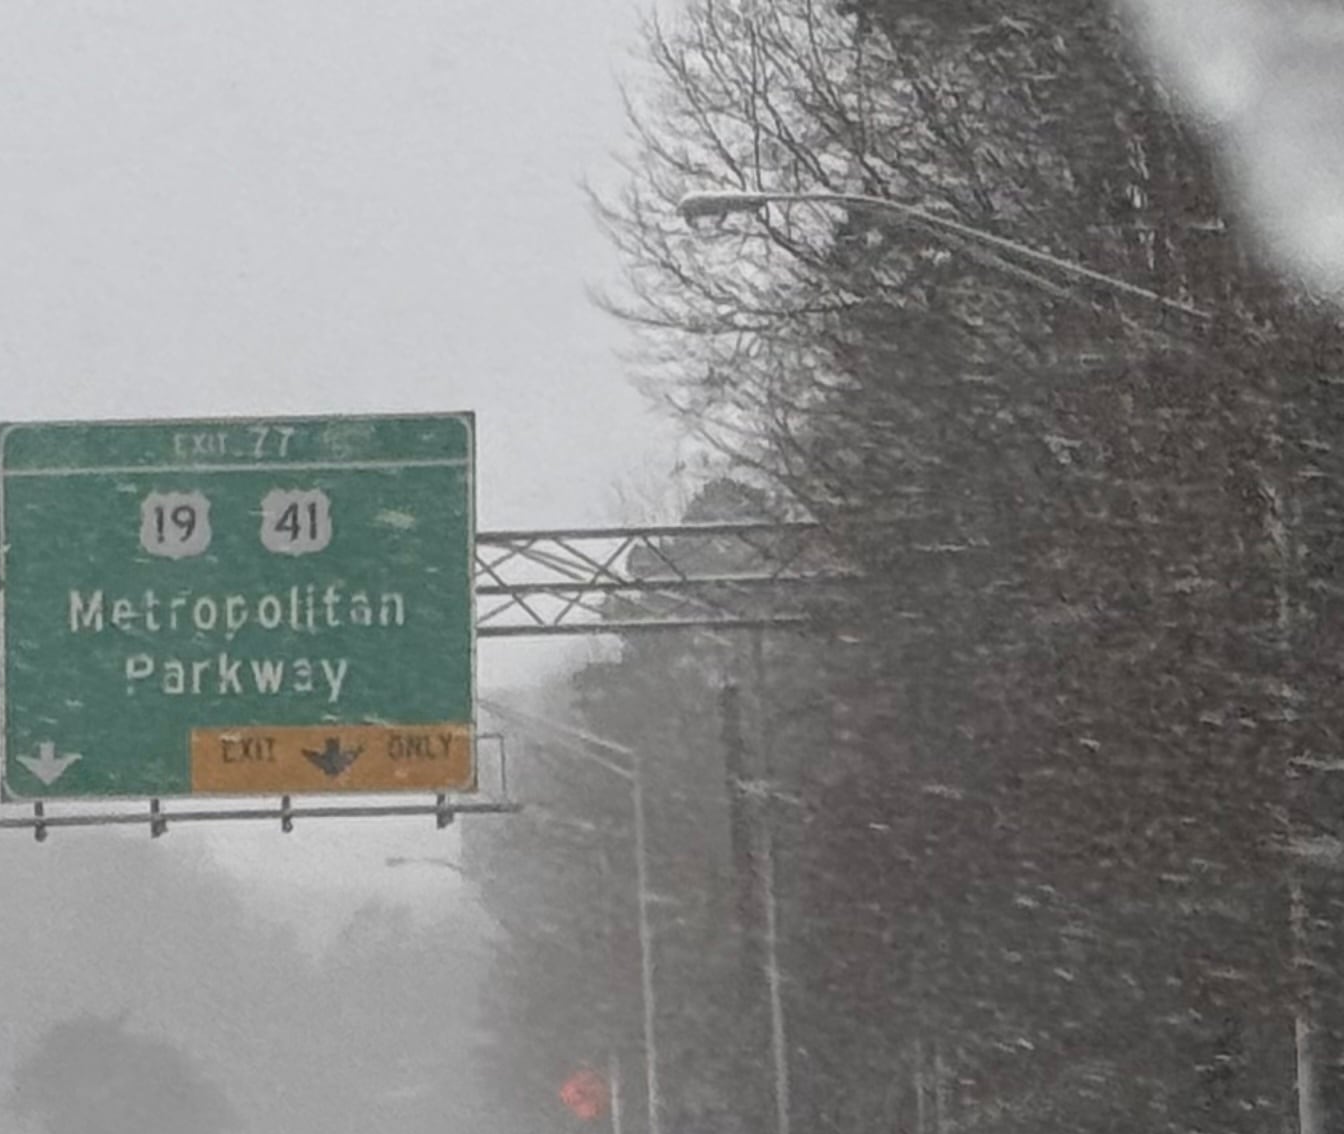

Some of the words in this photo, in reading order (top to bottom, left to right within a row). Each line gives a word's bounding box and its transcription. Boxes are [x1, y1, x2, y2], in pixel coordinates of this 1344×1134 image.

[173, 432, 227, 458] EXIT
[247, 425, 295, 459] 77
[154, 504, 197, 543] 19
[274, 502, 317, 541] 41
[69, 584, 406, 640] Metropolitan
[125, 651, 350, 704] Parkway
[220, 736, 276, 763] EXIT
[386, 732, 454, 761] ONLY
